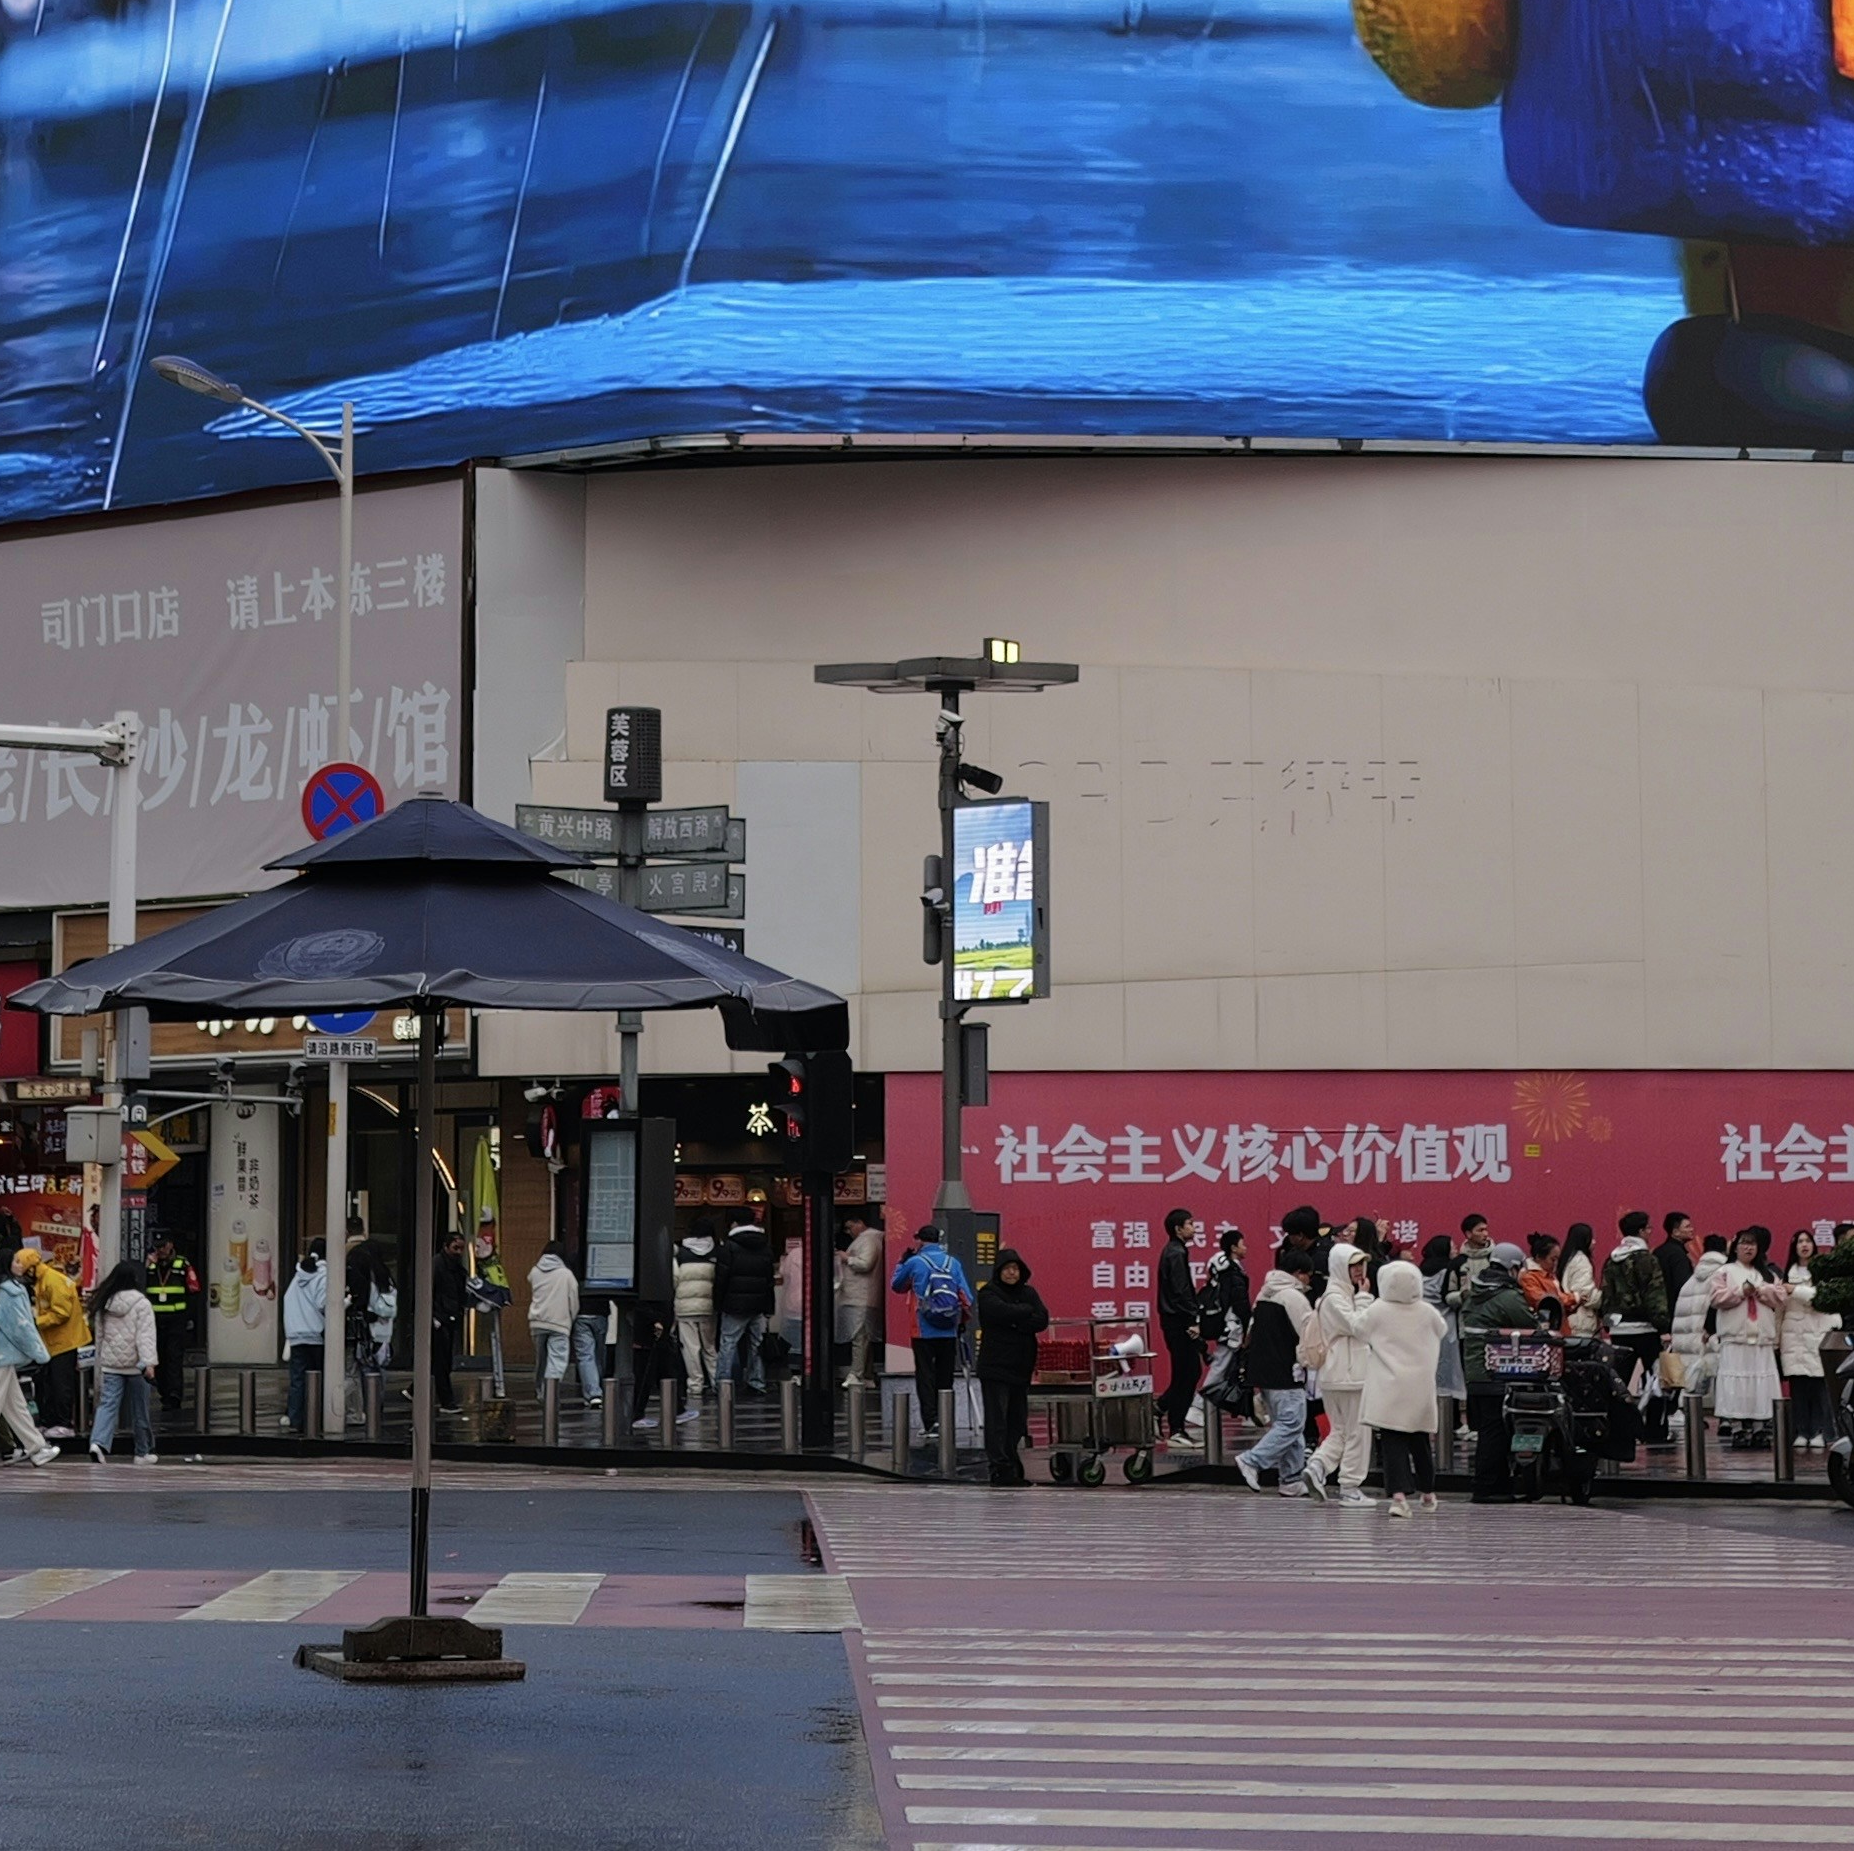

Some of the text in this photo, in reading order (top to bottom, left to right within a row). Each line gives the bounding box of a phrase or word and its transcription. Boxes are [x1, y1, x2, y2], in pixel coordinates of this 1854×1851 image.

[42, 553, 446, 651] 司门口店 请上本栋三楼
[610, 712, 631, 788] 芙蓉区
[538, 813, 613, 842] 黄兴中路
[647, 815, 709, 841] 解放西路
[649, 871, 707, 897] 火宫殿
[307, 1041, 375, 1056] 请沿路侧行驶
[746, 1102, 775, 1136] 茶
[995, 1122, 1513, 1185] 社会主义核心价值观
[1090, 1220, 1151, 1249] 富强
[1091, 1261, 1150, 1289] 自由
